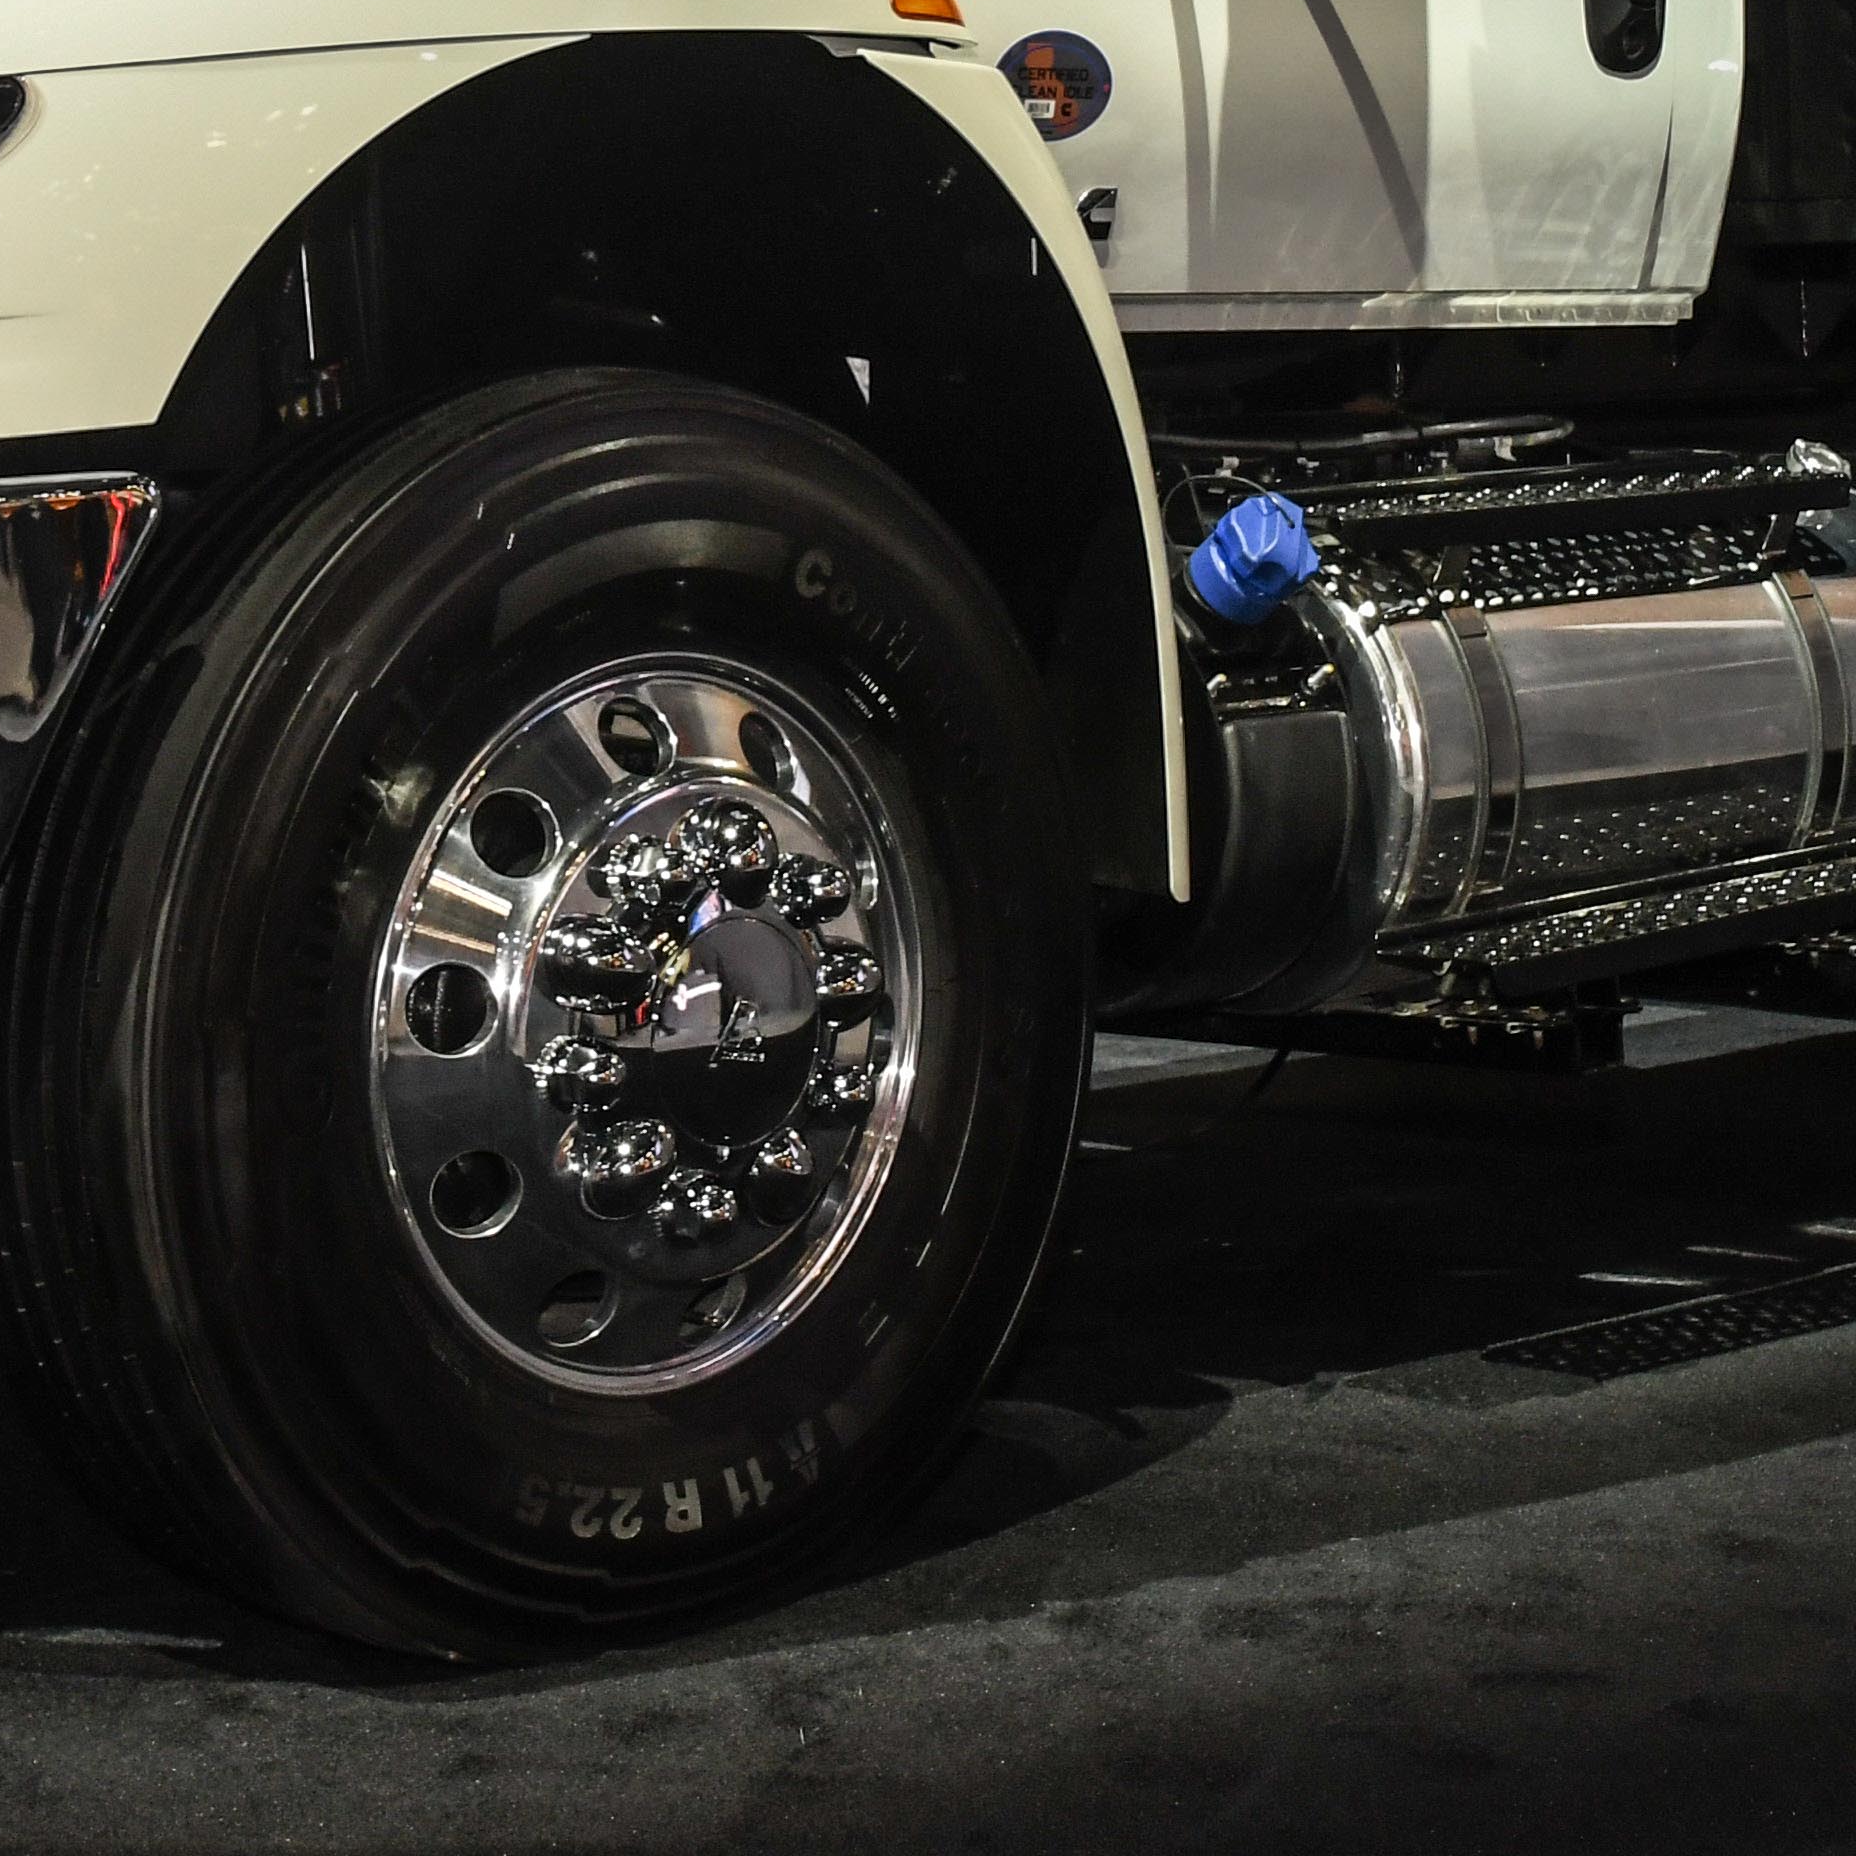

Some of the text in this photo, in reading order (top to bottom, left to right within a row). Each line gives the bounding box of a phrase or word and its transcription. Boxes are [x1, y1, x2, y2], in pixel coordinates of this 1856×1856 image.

[1017, 67, 1089, 82] CERTIFIED
[1064, 85, 1094, 99] IDLE
[663, 1477, 704, 1534] R
